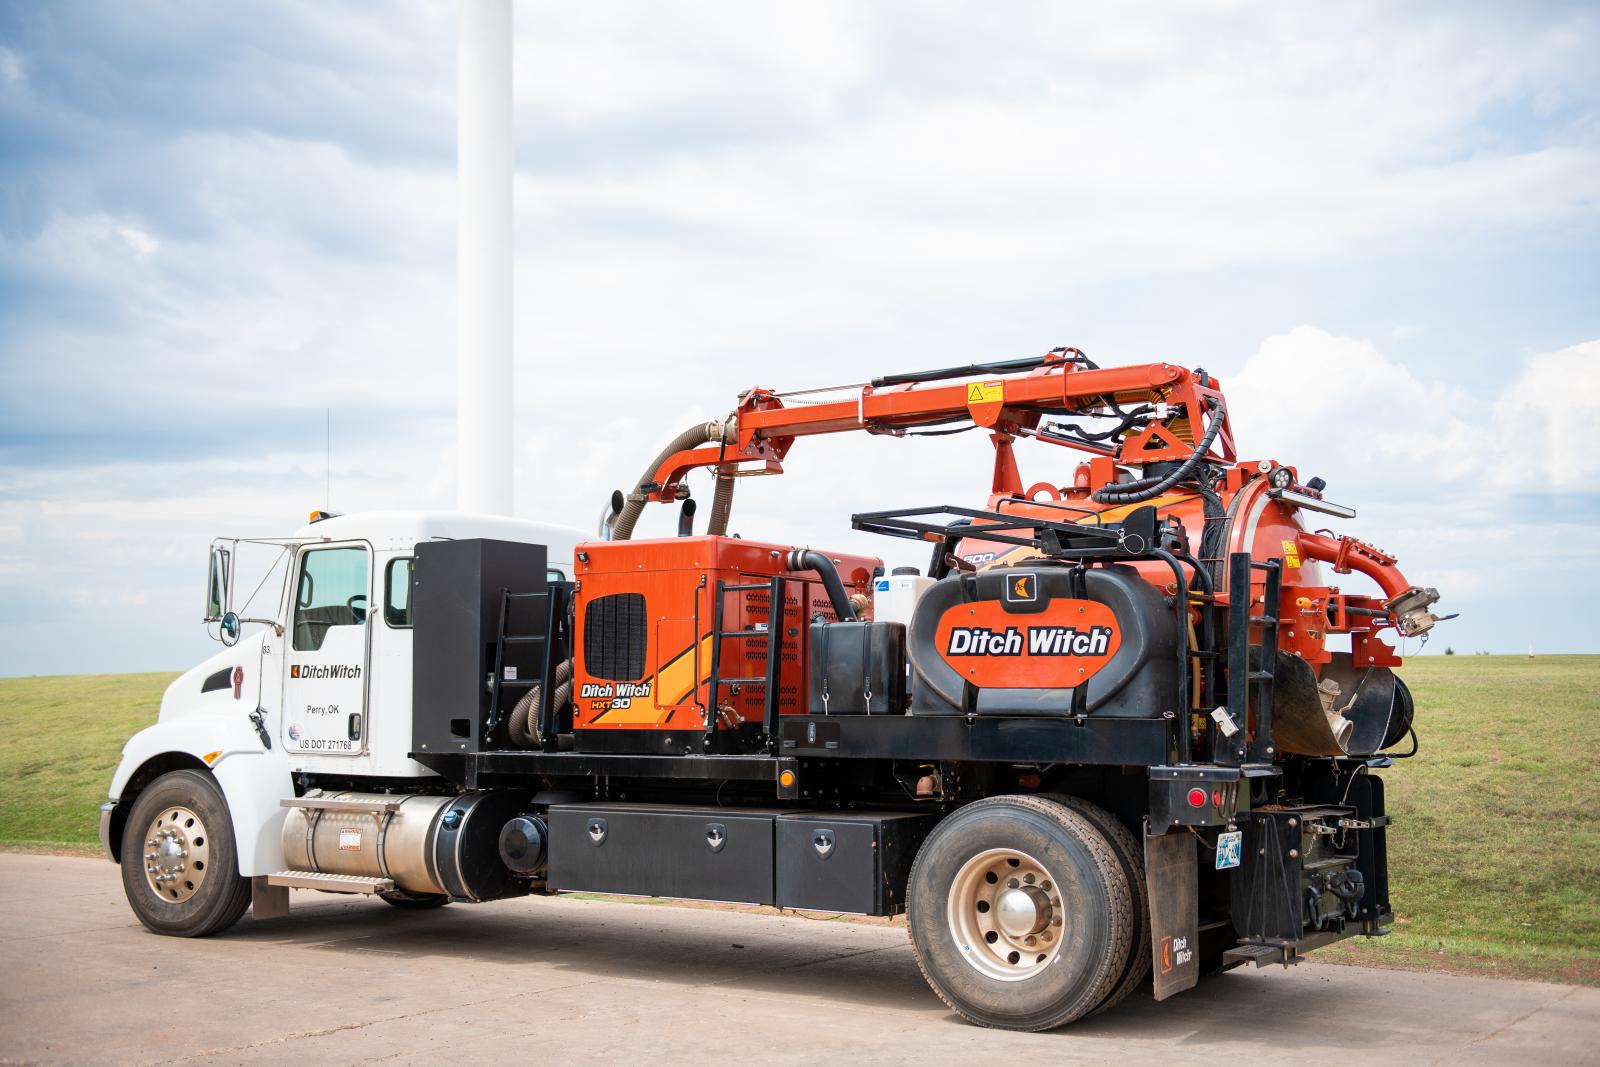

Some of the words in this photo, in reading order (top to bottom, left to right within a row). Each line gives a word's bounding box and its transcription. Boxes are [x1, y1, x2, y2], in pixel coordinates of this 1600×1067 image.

[949, 629, 1022, 654] Ditch
[581, 684, 613, 697] Ditch
[307, 705, 327, 716] Perry,
[328, 705, 339, 714] OK
[300, 740, 309, 749] US
[311, 740, 326, 749] DOT
[328, 741, 352, 750] 271768
[1173, 936, 1187, 952] Ditch
